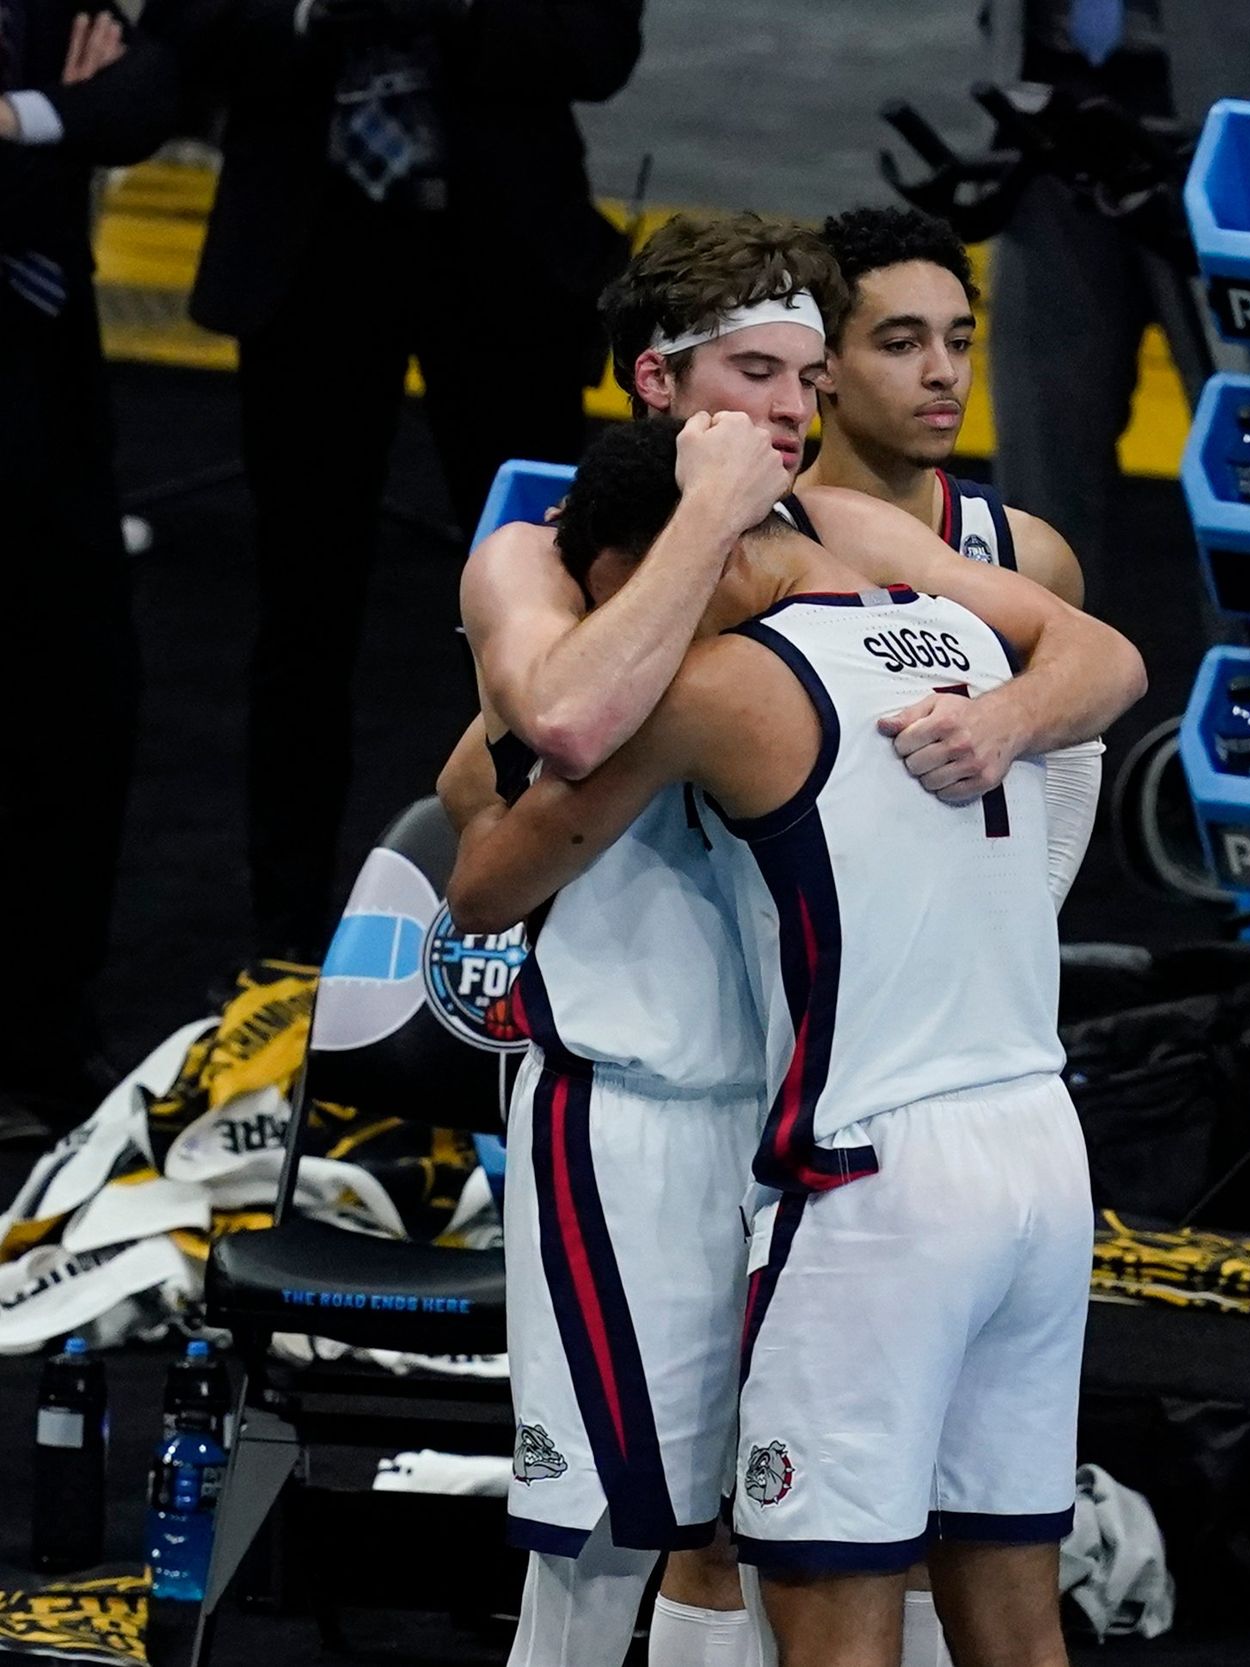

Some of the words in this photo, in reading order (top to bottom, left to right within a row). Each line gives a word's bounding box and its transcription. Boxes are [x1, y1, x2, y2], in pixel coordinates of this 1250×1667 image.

[863, 627, 971, 673] SUGGS
[320, 1291, 366, 1309] ROAD
[422, 1296, 470, 1315] HERE
